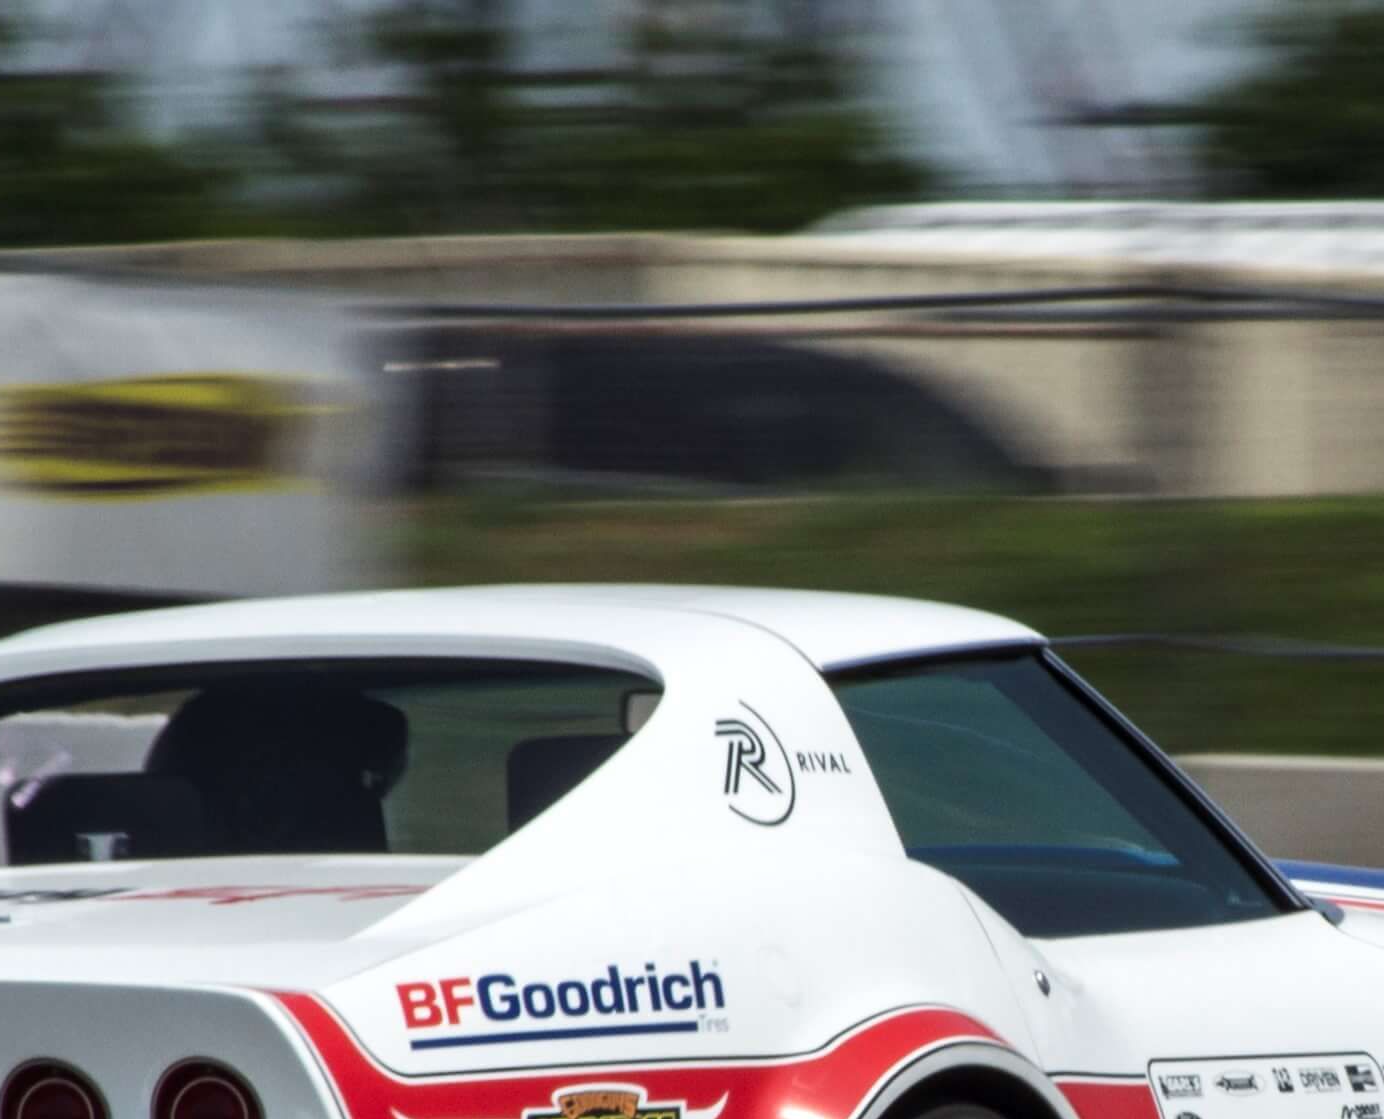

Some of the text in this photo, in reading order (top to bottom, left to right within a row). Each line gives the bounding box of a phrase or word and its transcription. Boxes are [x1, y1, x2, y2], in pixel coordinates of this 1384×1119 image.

[796, 751, 852, 774] RIVAL
[395, 960, 725, 1029] BFGoodrich
[1299, 1070, 1341, 1089] DRIVEN
